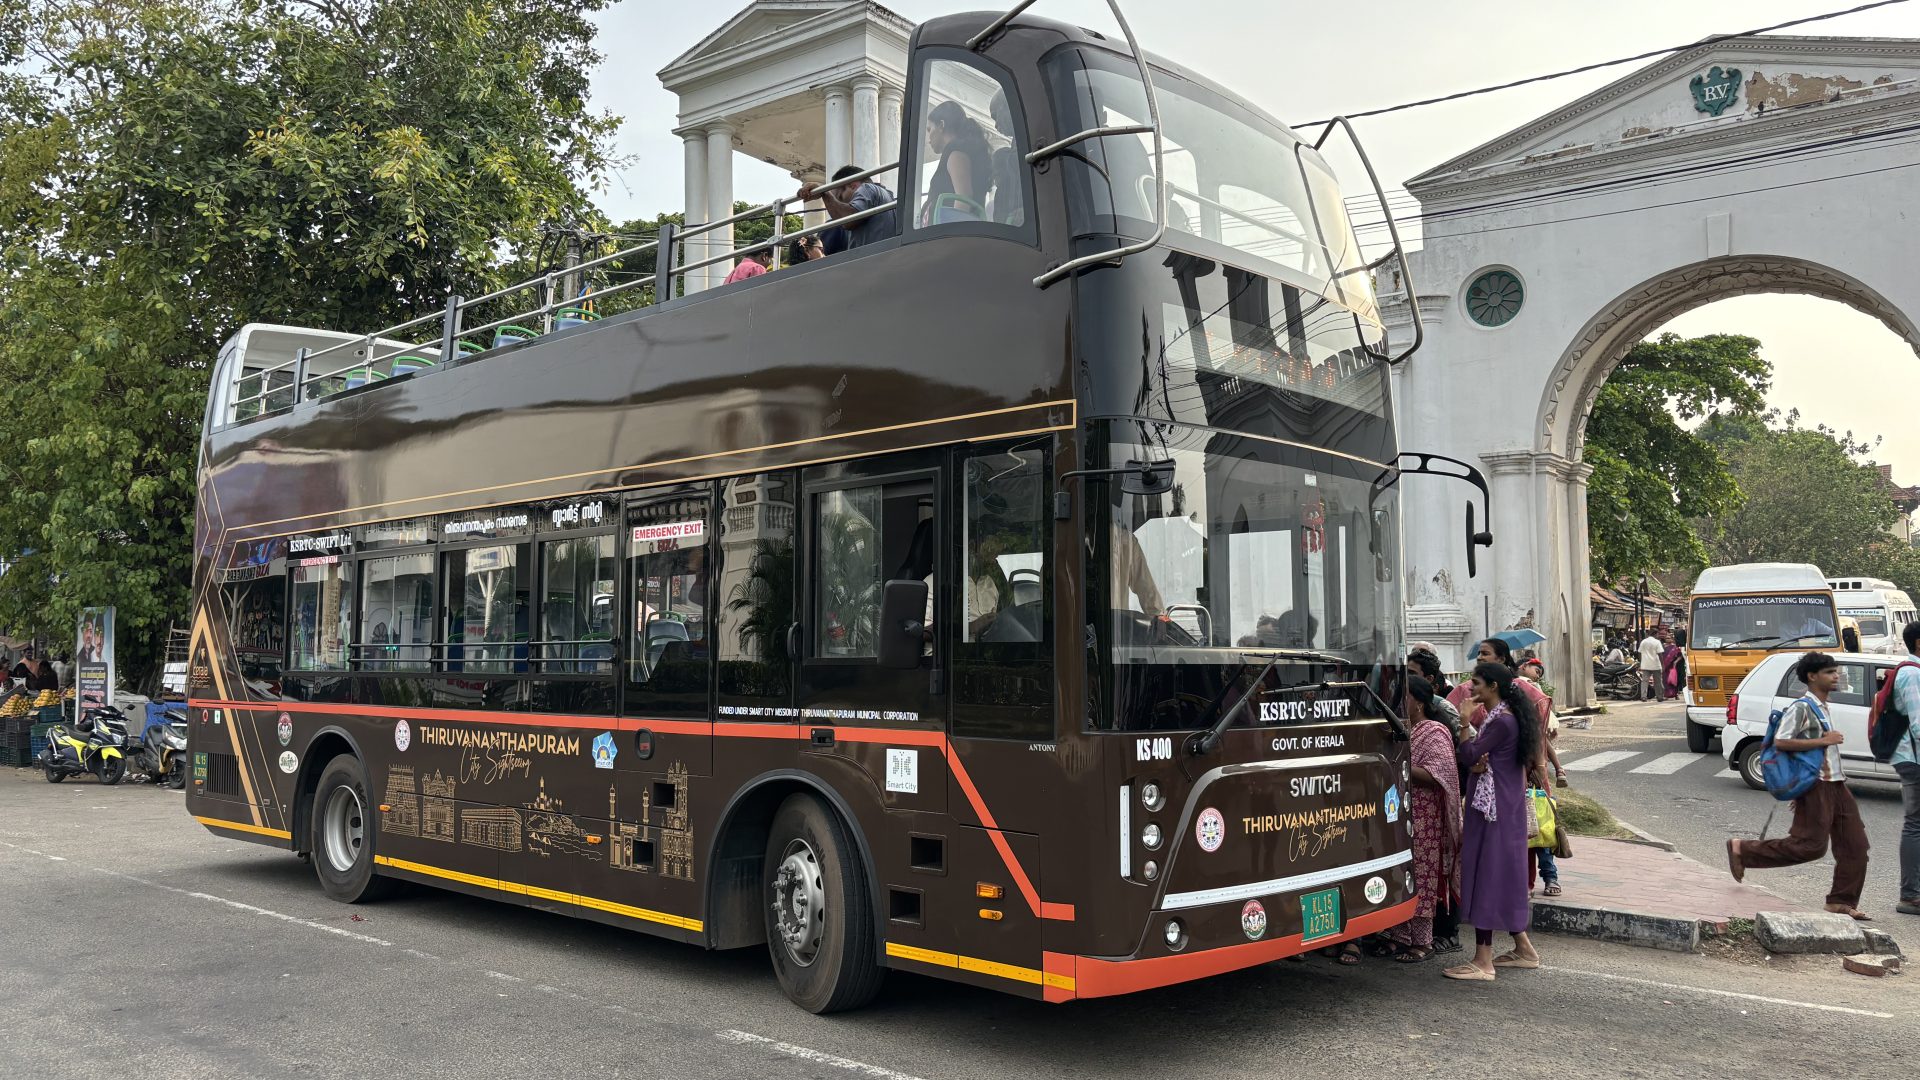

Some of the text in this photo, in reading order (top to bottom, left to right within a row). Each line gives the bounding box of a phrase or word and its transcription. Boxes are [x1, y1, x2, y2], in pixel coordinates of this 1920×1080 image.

[634, 522, 702, 540] EMERGENCY EXIT
[290, 535, 339, 552] KSRTC-SWIFT
[1698, 596, 1825, 609] RAJADHANI OUTDOOR CATERING DIVISION
[718, 706, 919, 721] FUNDED UNDER SMART CITY MISSION BY THIRUVANANTHAPURAM MUNICIPAL CORPORATION
[1259, 699, 1351, 721] KSRTC-SWIFT
[420, 726, 580, 756] THIRUVANANTHAPURAM
[1028, 743, 1057, 752] ANTONY
[1136, 737, 1172, 761] KS 400
[1272, 735, 1345, 751] GOVT. OF KERALA
[887, 780, 917, 792] Smart City
[1290, 774, 1341, 798] SWITCH
[1242, 802, 1376, 835] THIRUVANANTHAPURAM
[1312, 893, 1333, 914] KL 15
[1309, 911, 1336, 935] A2750
